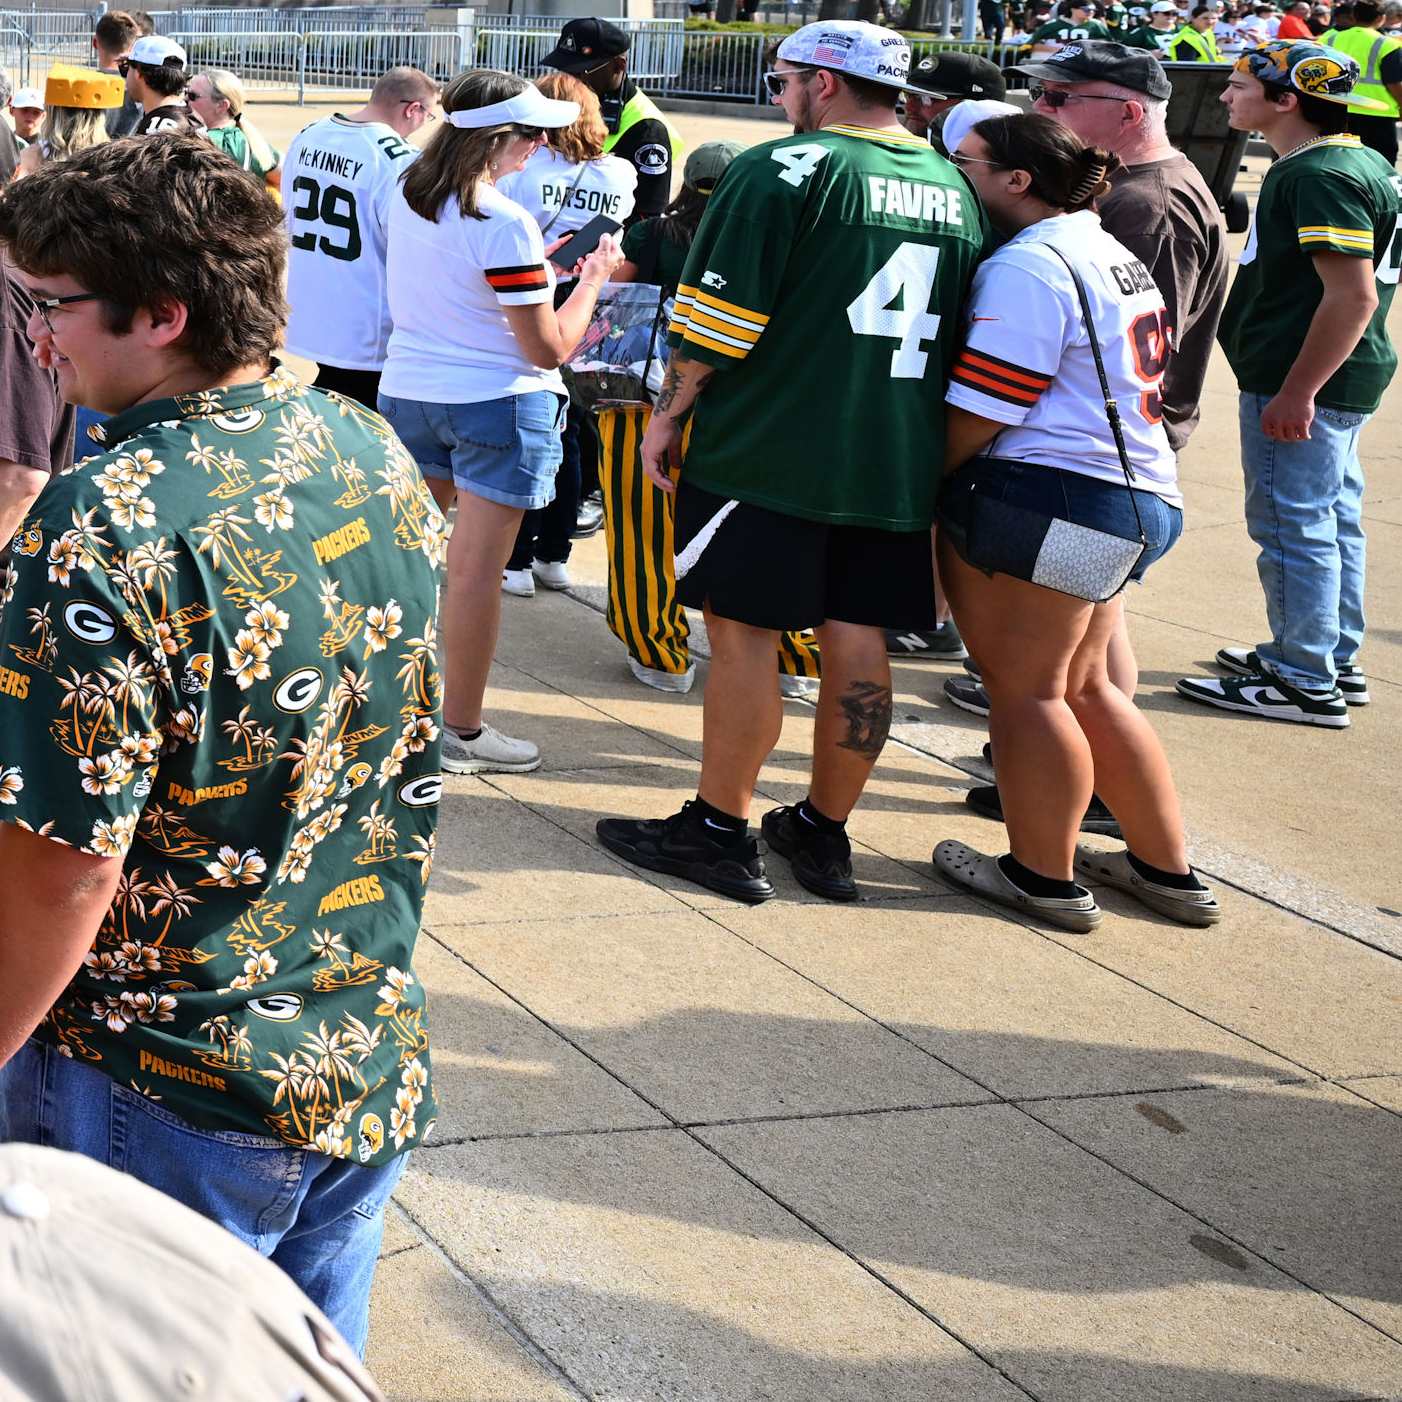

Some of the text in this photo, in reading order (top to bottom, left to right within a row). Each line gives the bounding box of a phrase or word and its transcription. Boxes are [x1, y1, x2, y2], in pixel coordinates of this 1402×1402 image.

[771, 143, 830, 188] 4
[292, 175, 363, 263] 29
[542, 184, 621, 216] PARSONS
[868, 176, 964, 227] FAVRE
[847, 241, 941, 380] 4
[313, 517, 371, 567] PACKERS
[317, 873, 385, 917] PACKERS
[139, 1049, 227, 1093] PACKERS
